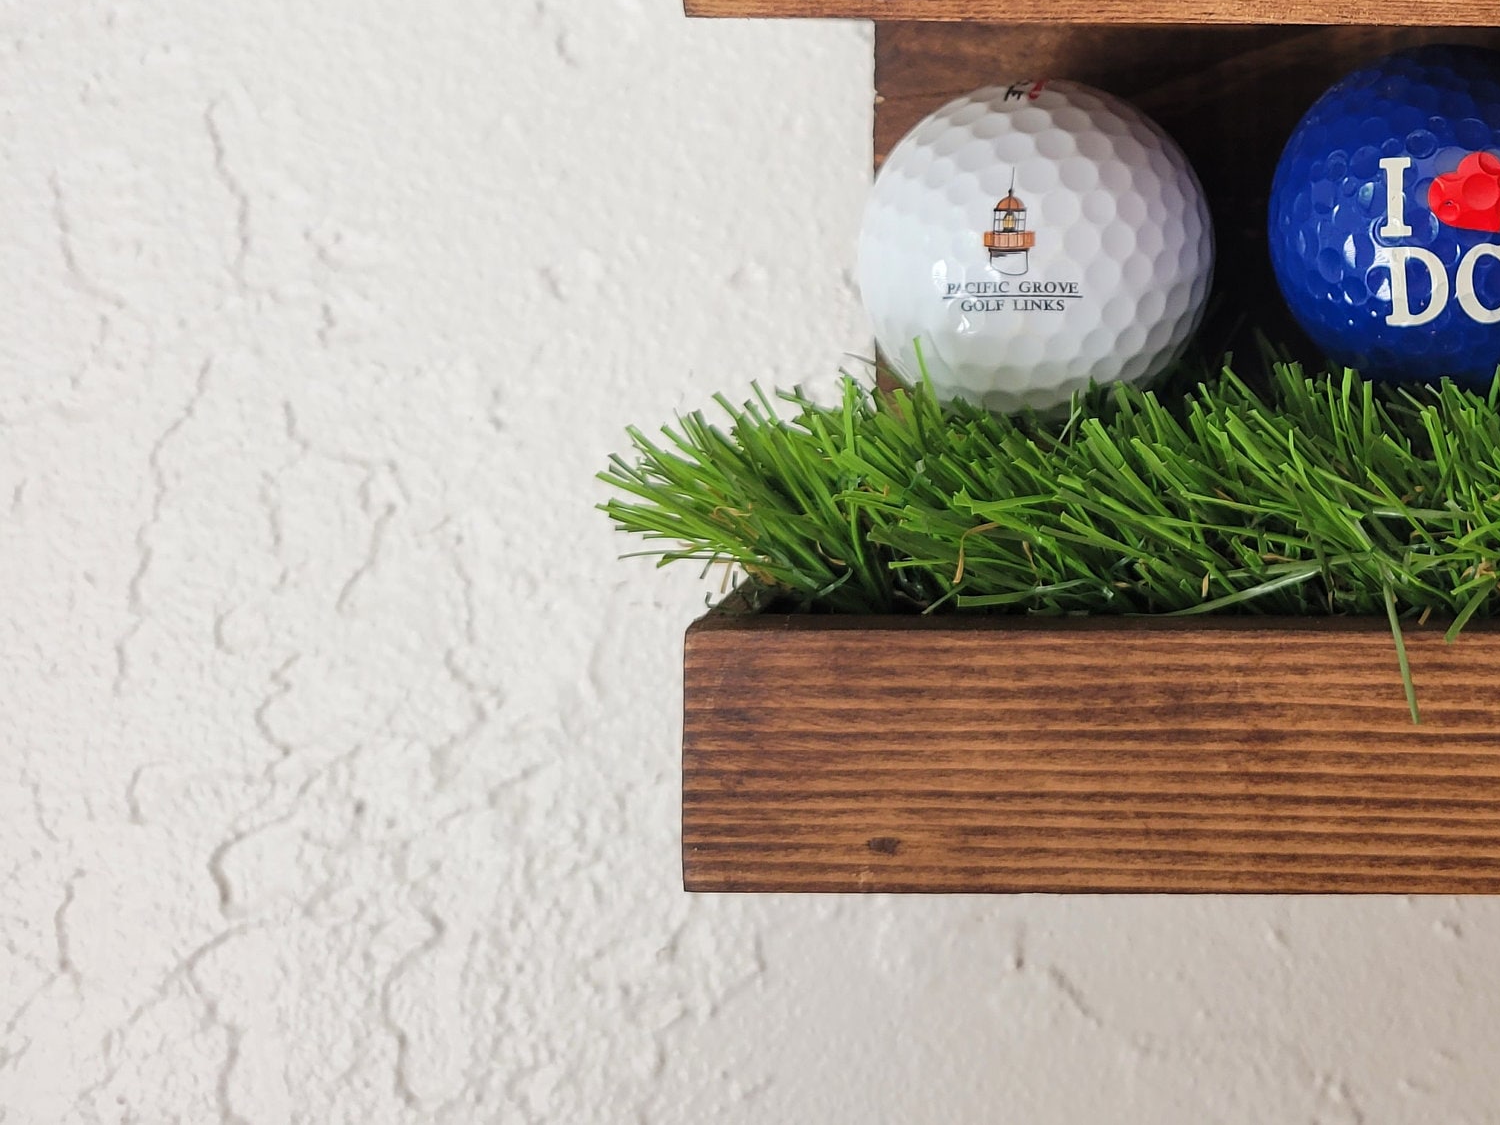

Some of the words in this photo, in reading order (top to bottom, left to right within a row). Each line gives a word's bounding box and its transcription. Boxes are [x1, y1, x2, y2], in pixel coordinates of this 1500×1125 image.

[1378, 157, 1413, 237] I
[1018, 281, 1080, 294] GROVE
[960, 299, 1006, 312] GOLF
[1013, 299, 1066, 312] LINKS
